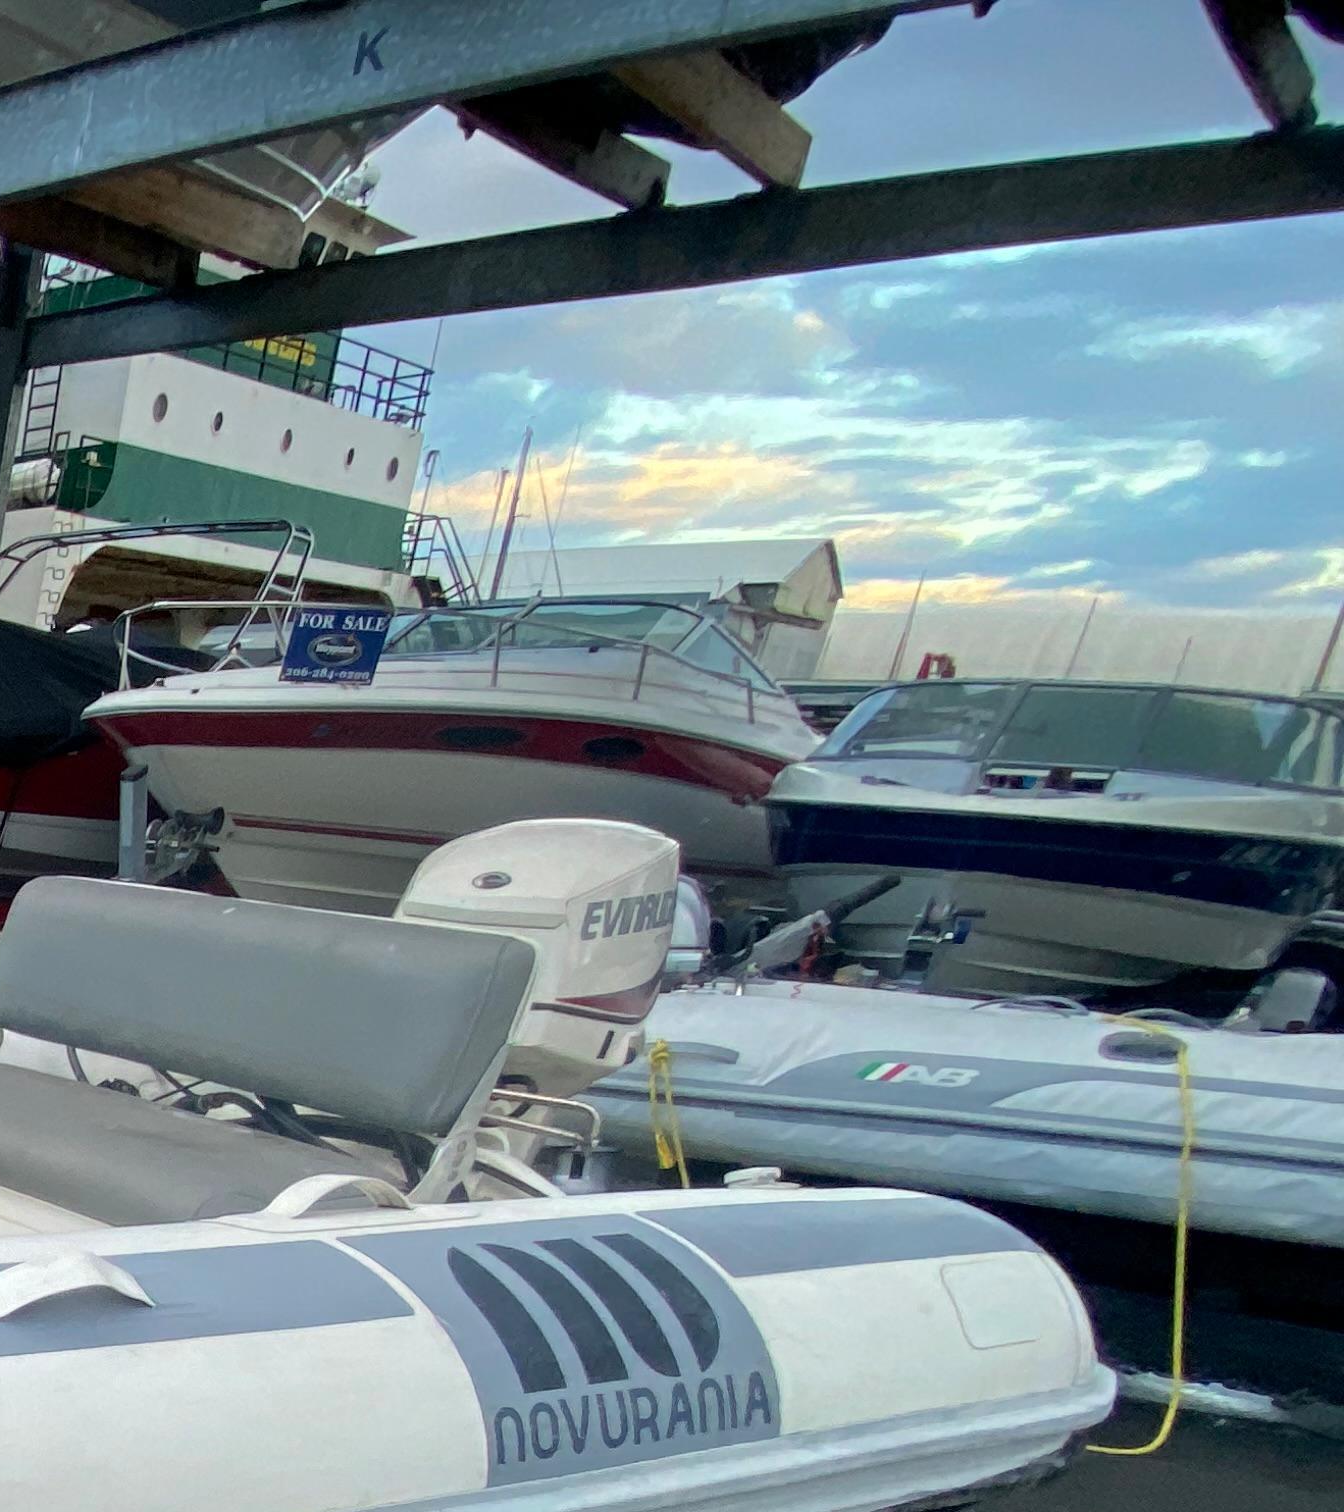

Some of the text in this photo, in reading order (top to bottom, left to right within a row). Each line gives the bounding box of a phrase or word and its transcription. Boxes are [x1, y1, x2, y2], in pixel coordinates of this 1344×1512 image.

[353, 25, 392, 76] K
[298, 613, 390, 632] FOR SALE
